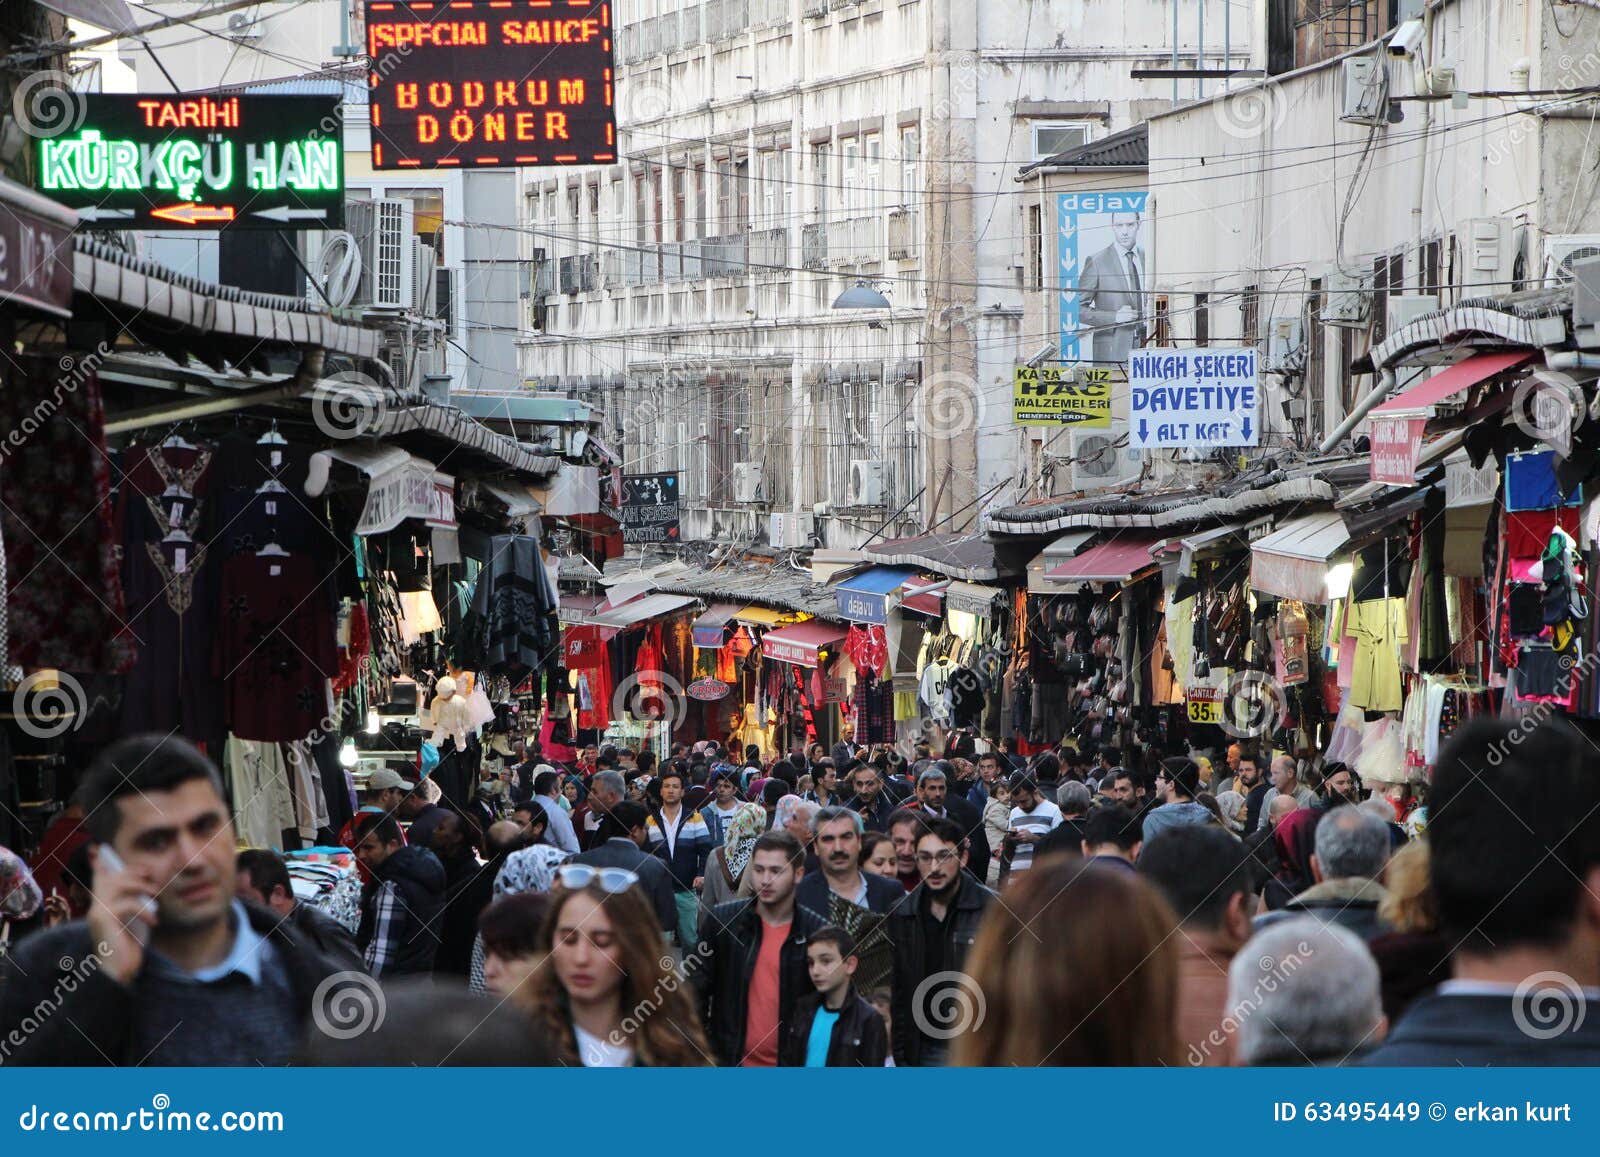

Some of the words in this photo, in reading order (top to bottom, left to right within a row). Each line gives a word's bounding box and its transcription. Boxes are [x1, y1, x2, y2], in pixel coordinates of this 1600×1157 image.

[138, 97, 239, 127] TARİHİ
[417, 110, 569, 143] DÖNER
[41, 129, 232, 201] KÜRKÇÜ
[246, 140, 338, 190] HAN
[1017, 369, 1110, 381] KARANİZ
[1132, 352, 1187, 380] NİKAH
[1194, 351, 1254, 383] ŞEKERİ
[1015, 398, 1110, 409] MALZEMELERİ
[1132, 381, 1255, 412] DAVETİYE
[1158, 423, 1189, 441] ALT
[1196, 423, 1231, 441] KAT
[848, 594, 873, 618] dejavu
[1191, 702, 1210, 721] 35
